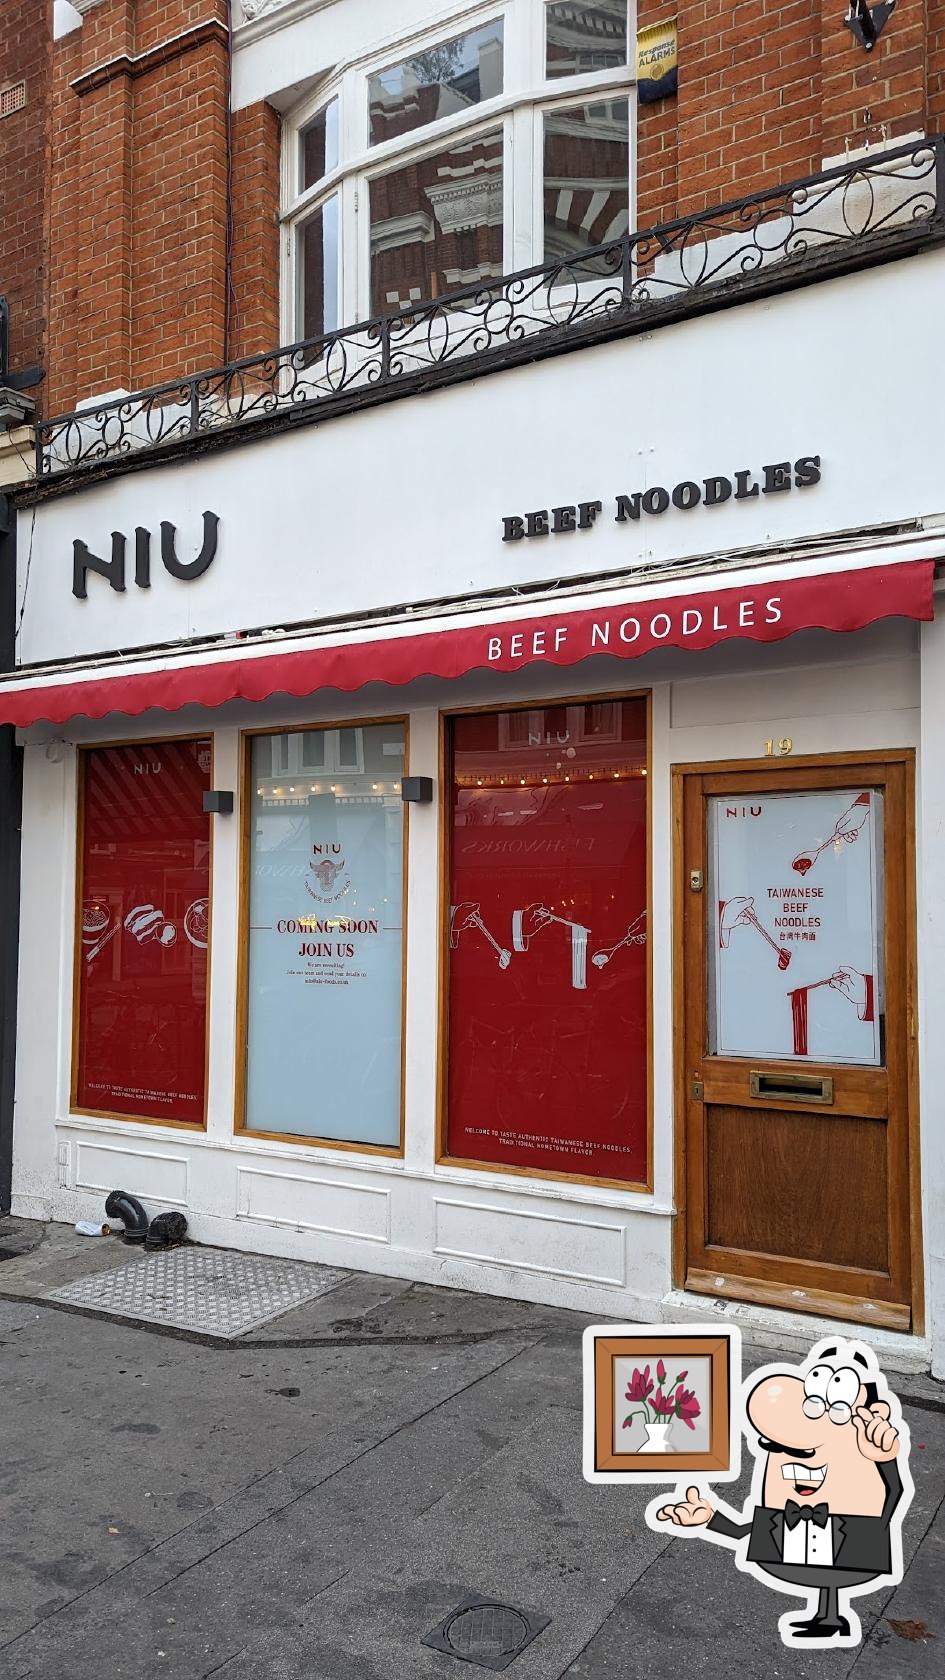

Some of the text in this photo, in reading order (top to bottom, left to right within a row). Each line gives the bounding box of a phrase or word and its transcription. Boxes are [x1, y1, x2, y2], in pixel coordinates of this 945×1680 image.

[639, 46, 676, 68] ALARMS
[501, 455, 822, 541] BEEF NOODLES
[72, 510, 220, 599] NIU
[487, 597, 782, 661] BEEF NOODLES
[528, 729, 570, 746] NIU
[763, 737, 793, 757] 19
[134, 762, 162, 775] NIU
[726, 806, 762, 818] NIU
[313, 843, 341, 855] NIU
[767, 888, 824, 899] TAIWANESE
[783, 903, 809, 913] BEEF
[277, 919, 380, 934] COMING SOON
[774, 917, 821, 928] NOODLES
[298, 943, 354, 957] JOIN US
[465, 1127, 490, 1135] WELCOME
[500, 1131, 516, 1139] TASTE
[518, 1133, 549, 1142] AUTHENTIC
[550, 1137, 584, 1147] TAIWANESE
[499, 1138, 535, 1148] TRADITIONAL
